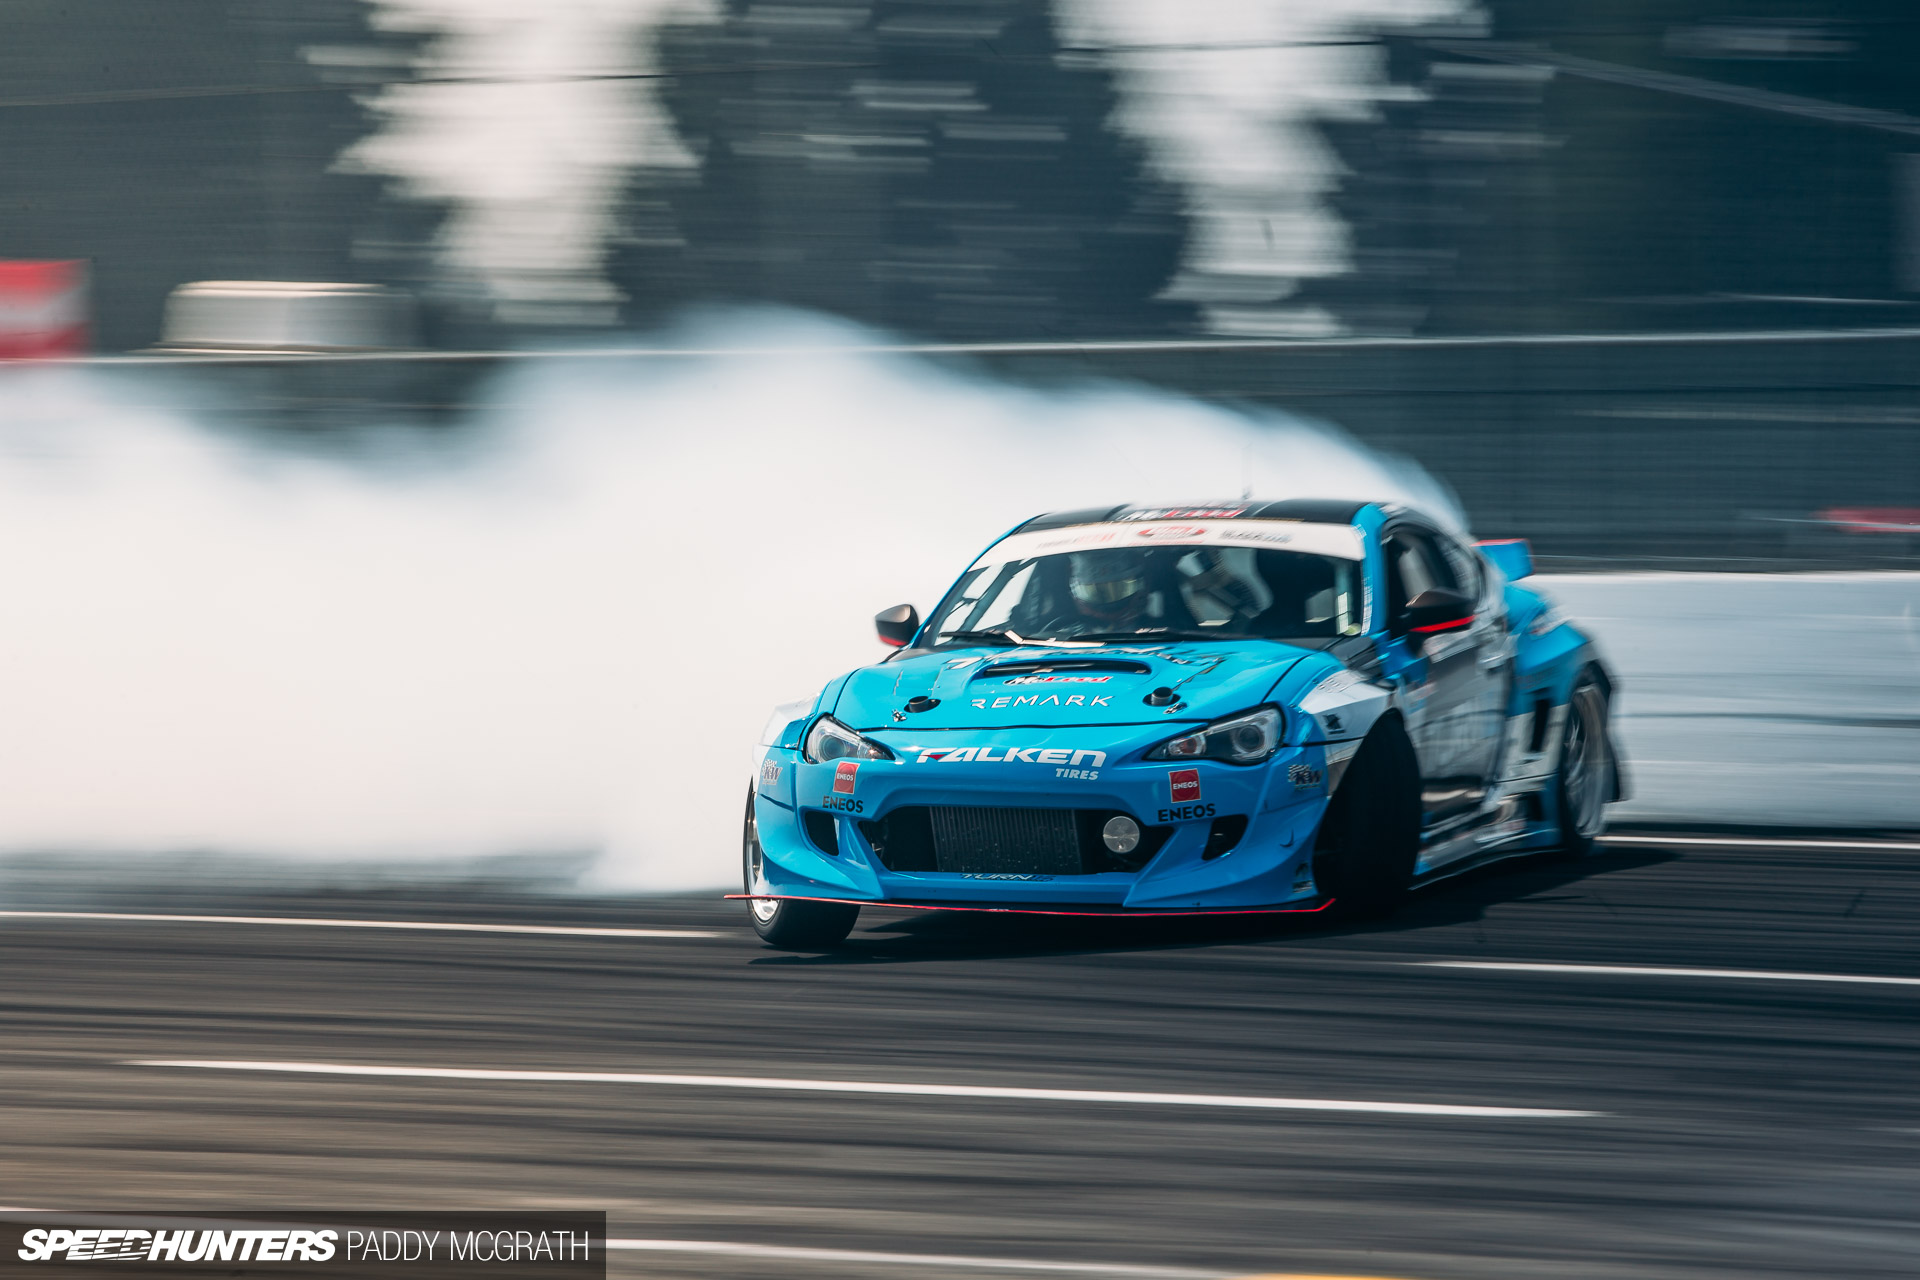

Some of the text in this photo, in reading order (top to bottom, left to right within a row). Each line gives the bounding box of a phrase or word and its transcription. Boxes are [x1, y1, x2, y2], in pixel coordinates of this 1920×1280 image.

[970, 694, 1115, 710] REMARK
[915, 747, 1107, 768] FALKEN
[836, 772, 854, 782] ENEOS
[1055, 768, 1099, 780] TIRES
[1172, 780, 1198, 790] ENEOS
[822, 795, 864, 814] ENEOS
[1157, 803, 1216, 822] ENEOS
